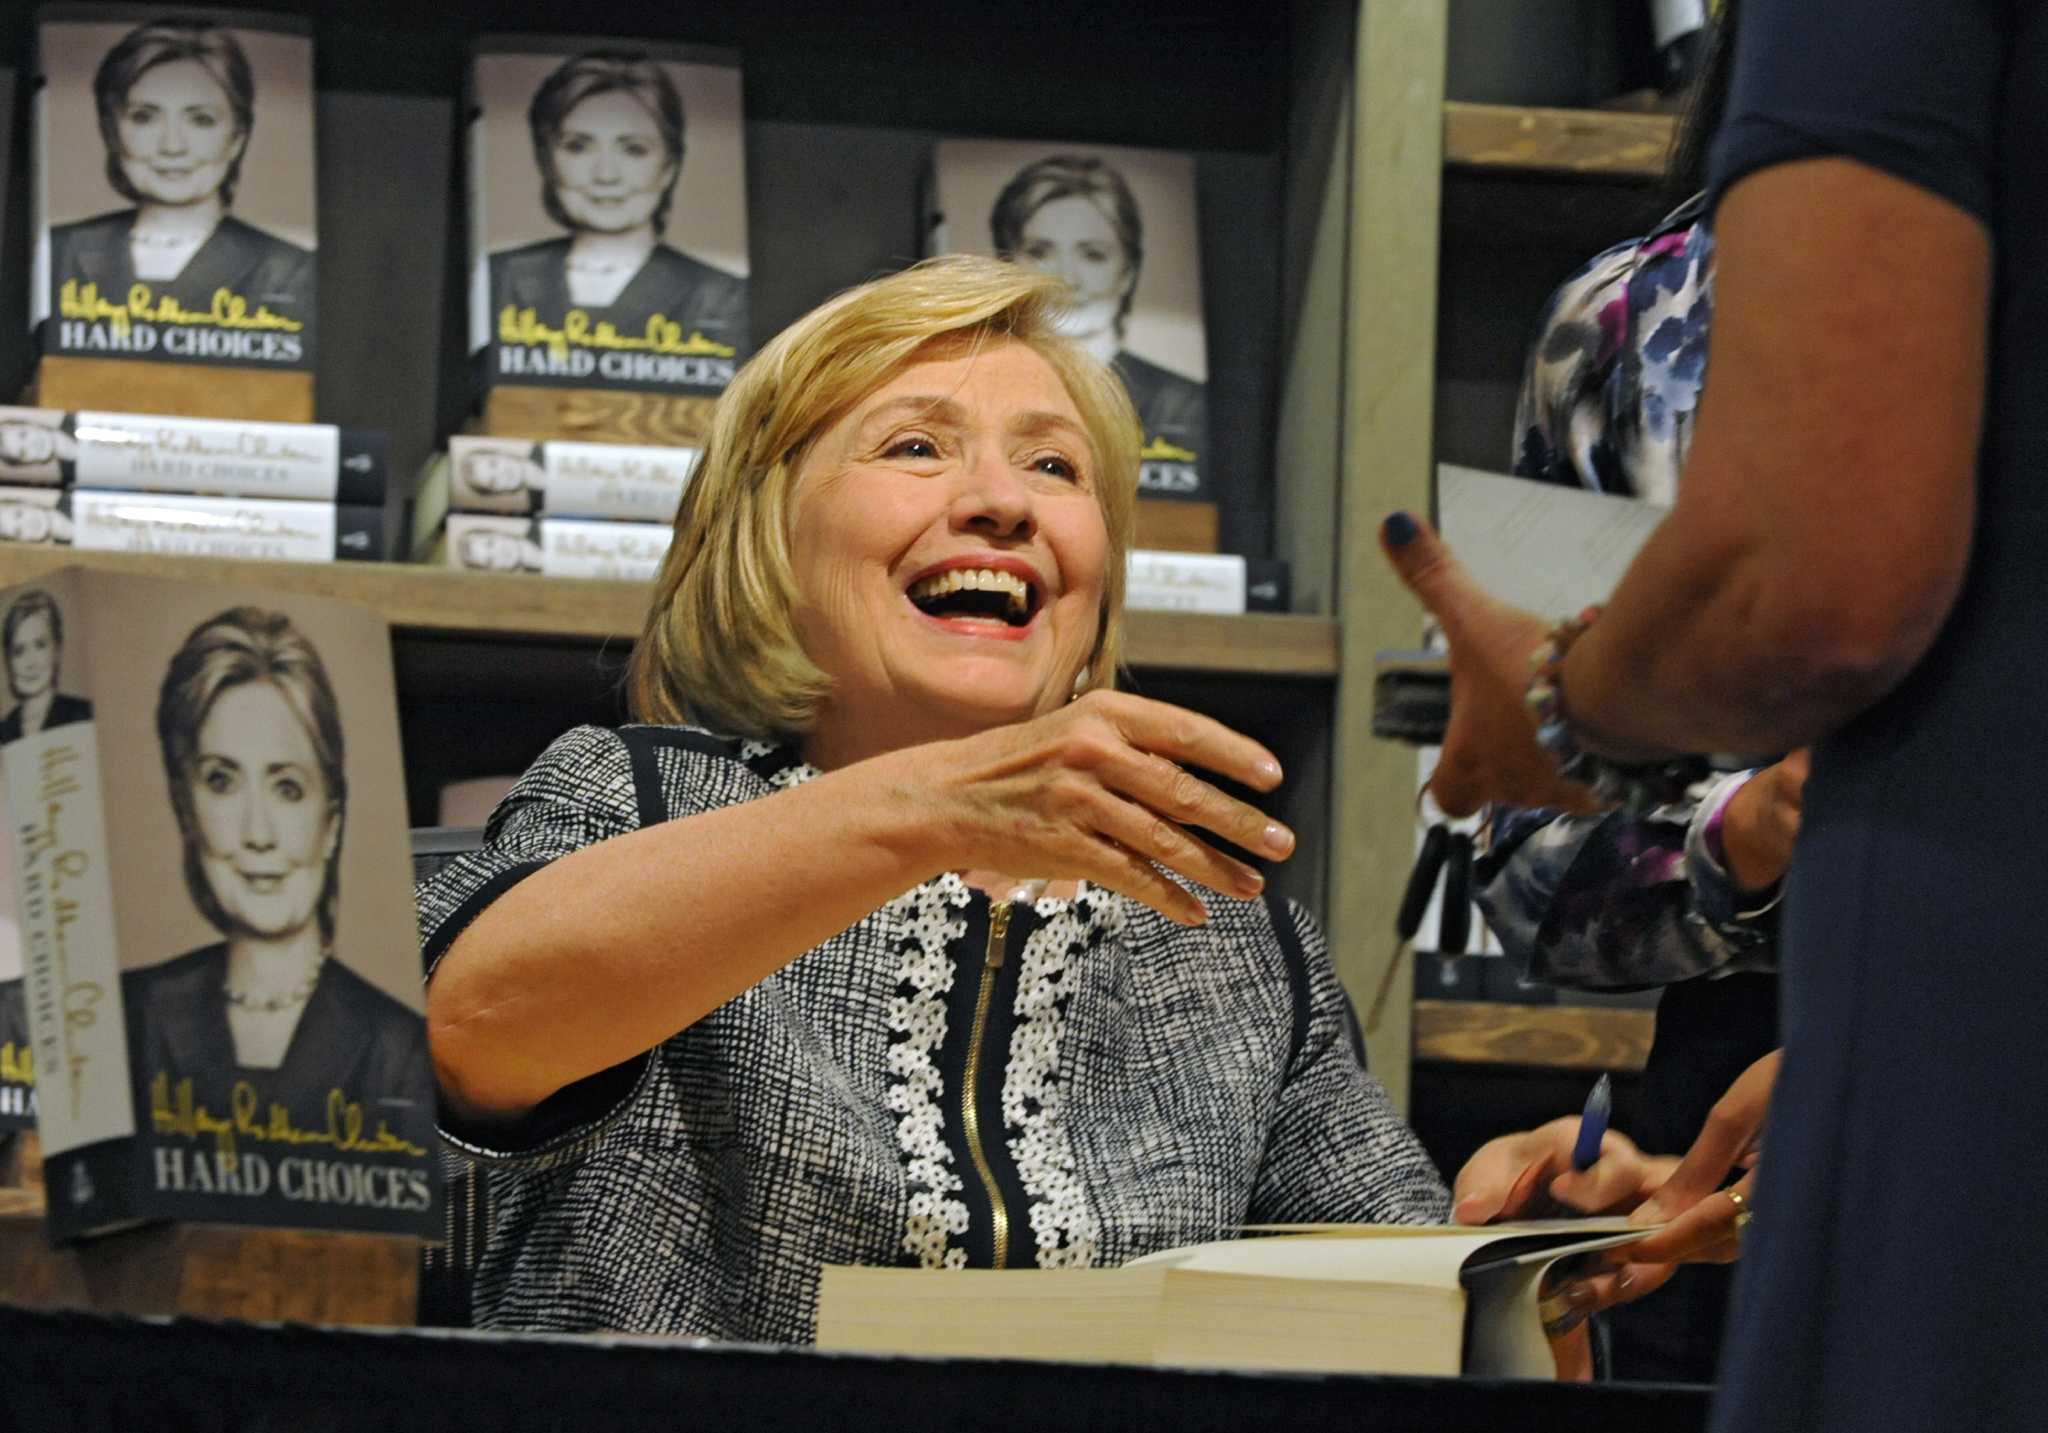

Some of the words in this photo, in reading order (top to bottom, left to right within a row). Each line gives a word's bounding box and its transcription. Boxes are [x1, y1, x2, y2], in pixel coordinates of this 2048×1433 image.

[60, 320, 158, 351] HARD
[162, 325, 303, 362] CHOICES
[500, 346, 596, 378] HARD
[600, 351, 736, 387] CHOICES
[154, 1146, 271, 1197] HARD
[277, 1156, 432, 1213] CHOICES
